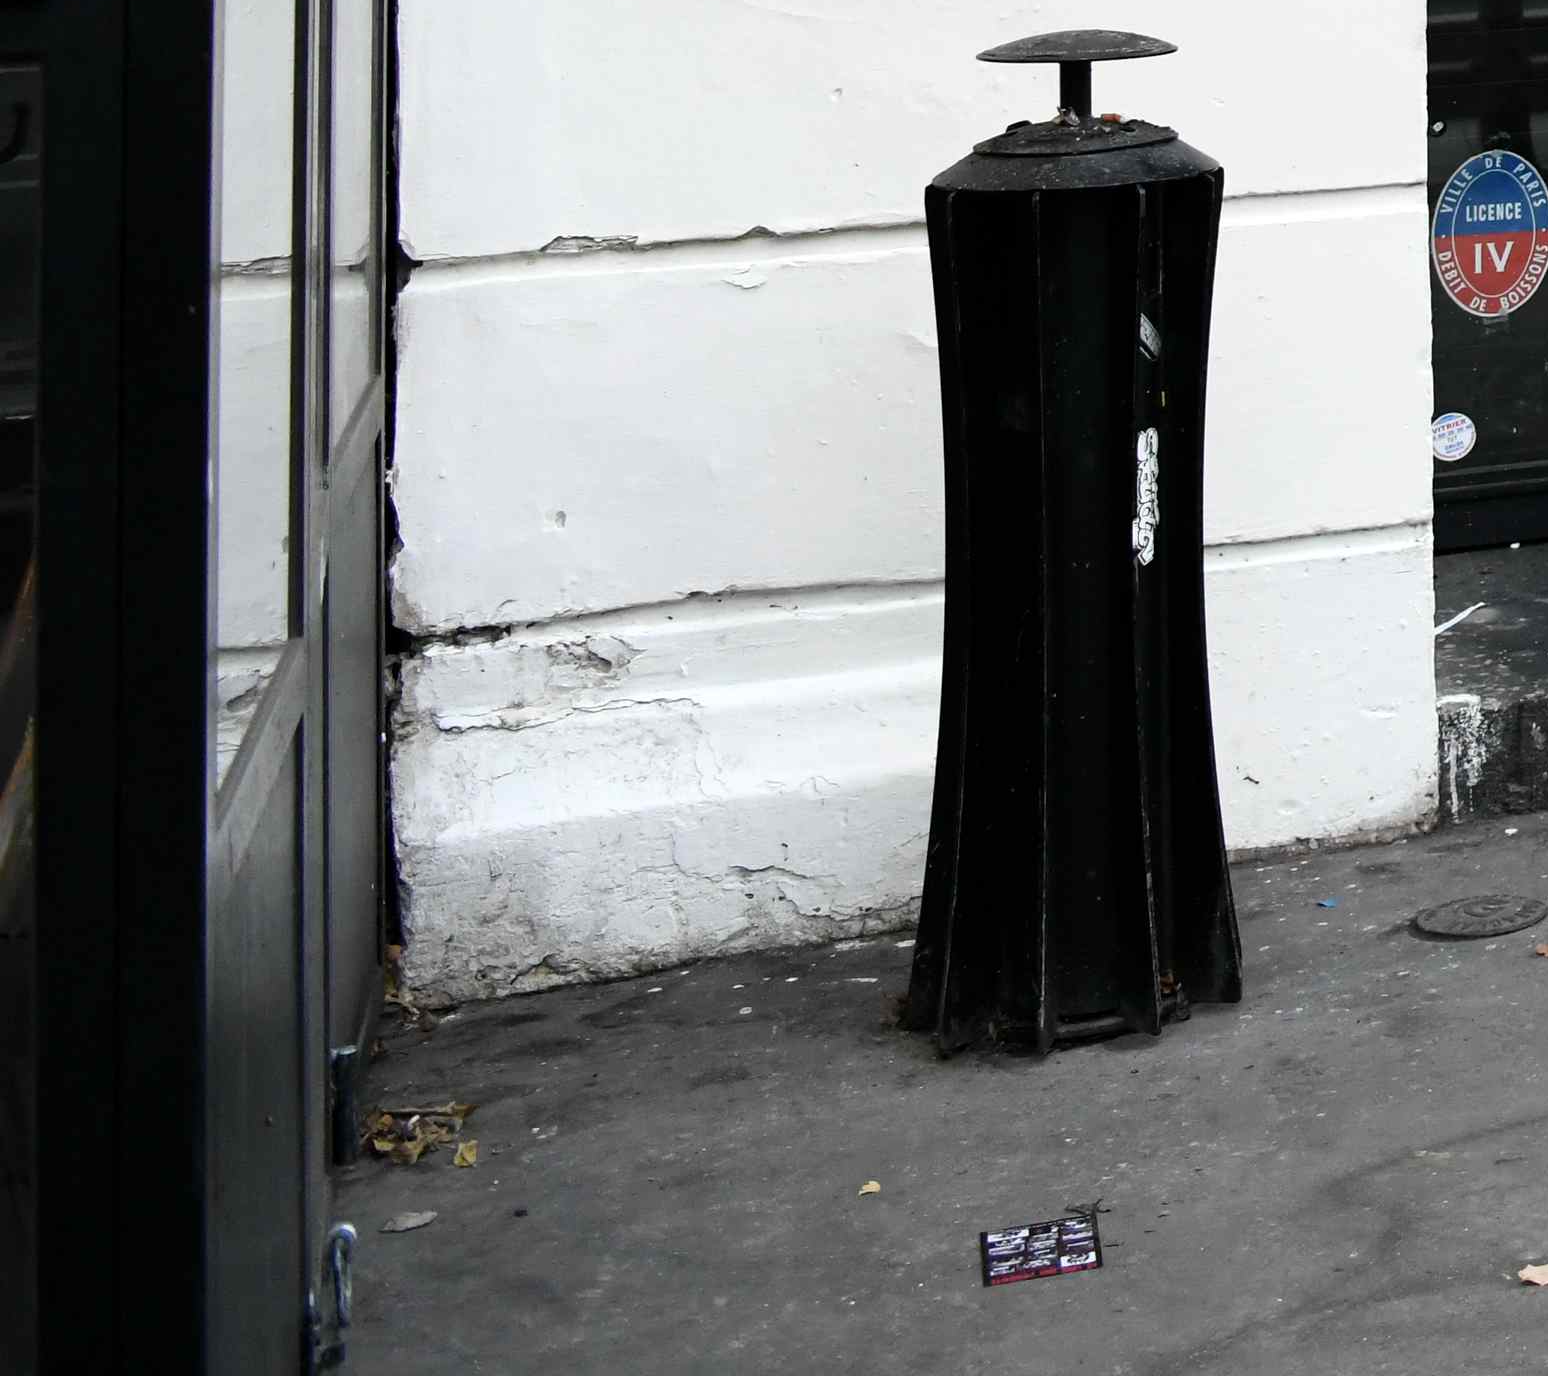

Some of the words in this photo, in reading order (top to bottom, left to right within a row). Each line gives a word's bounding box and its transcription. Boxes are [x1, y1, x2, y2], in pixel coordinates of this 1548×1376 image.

[1440, 168, 1472, 213] VILLE
[1485, 156, 1503, 169] DE
[1513, 163, 1547, 208] PARIS
[1466, 202, 1522, 223] LICENCE
[1438, 251, 1469, 294] DEBIT
[1470, 296, 1488, 312] DE
[1500, 244, 1548, 310] BOISSONS
[1474, 240, 1515, 274] IV
